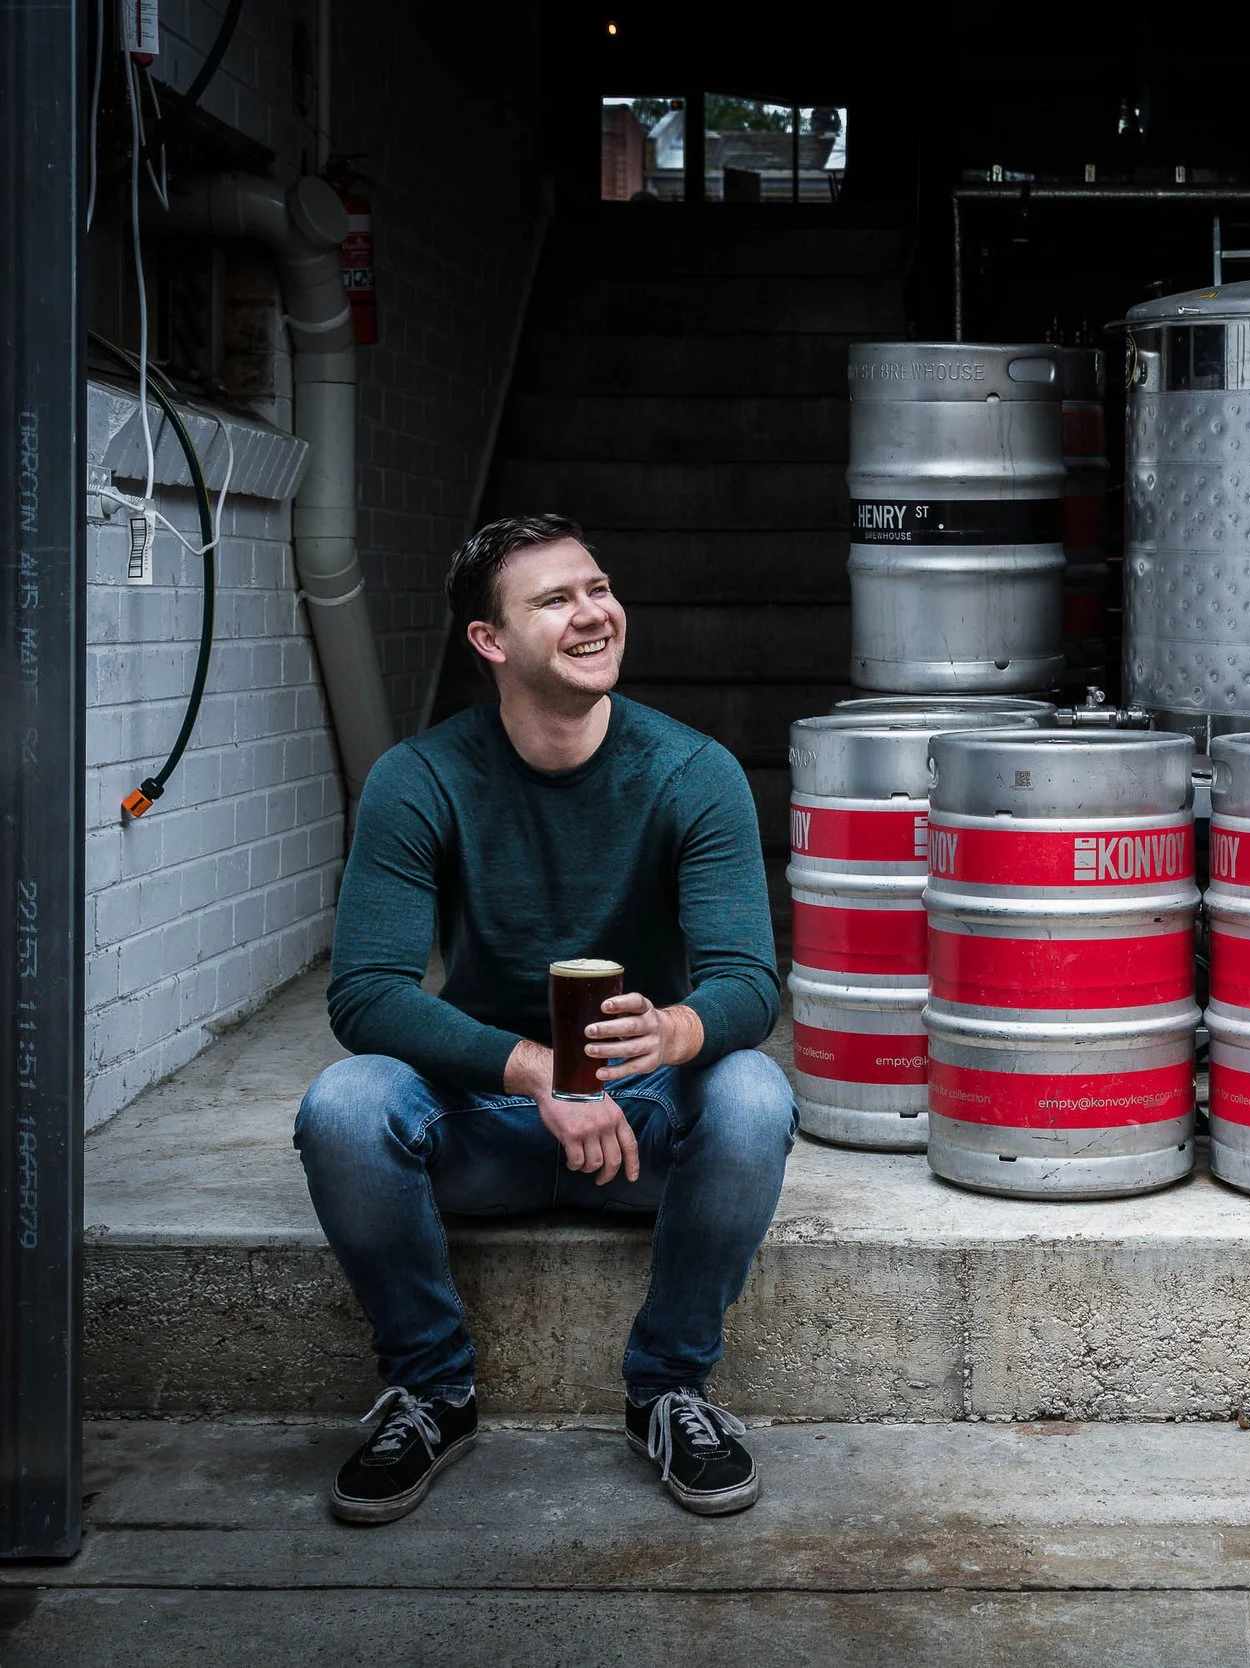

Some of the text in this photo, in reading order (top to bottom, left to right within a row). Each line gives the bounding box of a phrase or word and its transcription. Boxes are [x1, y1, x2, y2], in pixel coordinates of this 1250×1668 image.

[880, 363, 985, 381] BREWHOUSE
[858, 504, 929, 529] HENRY ST
[865, 531, 912, 541] BREWHOUSE
[1098, 831, 1185, 880] KONVOY
[803, 1045, 835, 1062] collection
[948, 1089, 991, 1105] collection
[1038, 1089, 1173, 1111] empty@konvoykegs.com
